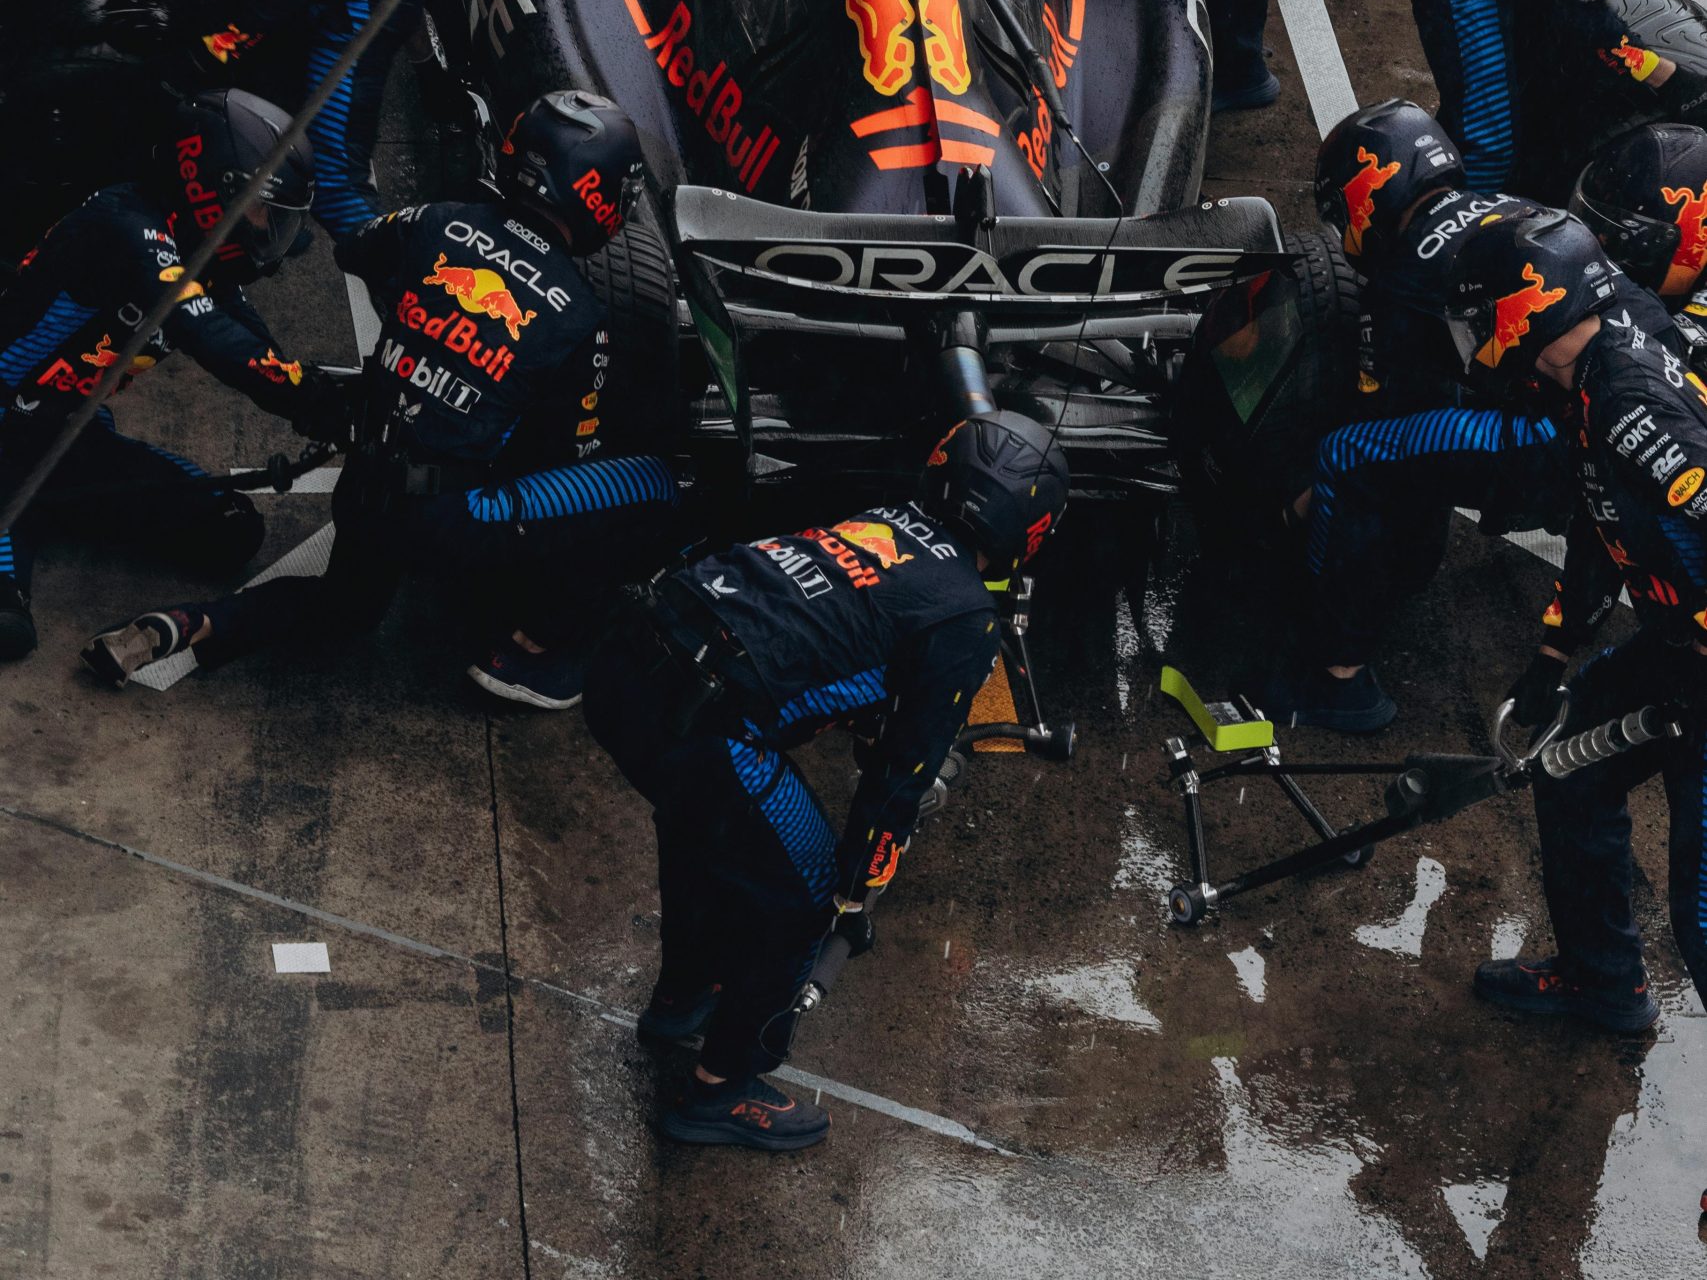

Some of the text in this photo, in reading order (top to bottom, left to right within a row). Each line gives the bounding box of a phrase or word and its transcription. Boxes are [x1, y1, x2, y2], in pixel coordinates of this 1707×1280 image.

[1041, 1, 1079, 89] ull
[644, 0, 782, 193] Red Bull
[176, 134, 247, 262] Red Bll
[571, 167, 617, 225] Red
[503, 218, 551, 255] sparco
[444, 220, 572, 313] ORACLE
[754, 243, 1240, 296] ORACLE
[181, 296, 214, 318] VIS
[397, 289, 517, 384] Red Bull
[381, 338, 452, 398] Mobil
[1607, 404, 1647, 445] infinitum
[1616, 414, 1658, 458] ROKT
[1676, 472, 1700, 497] RAUCH
[867, 830, 894, 878] Red Bull
